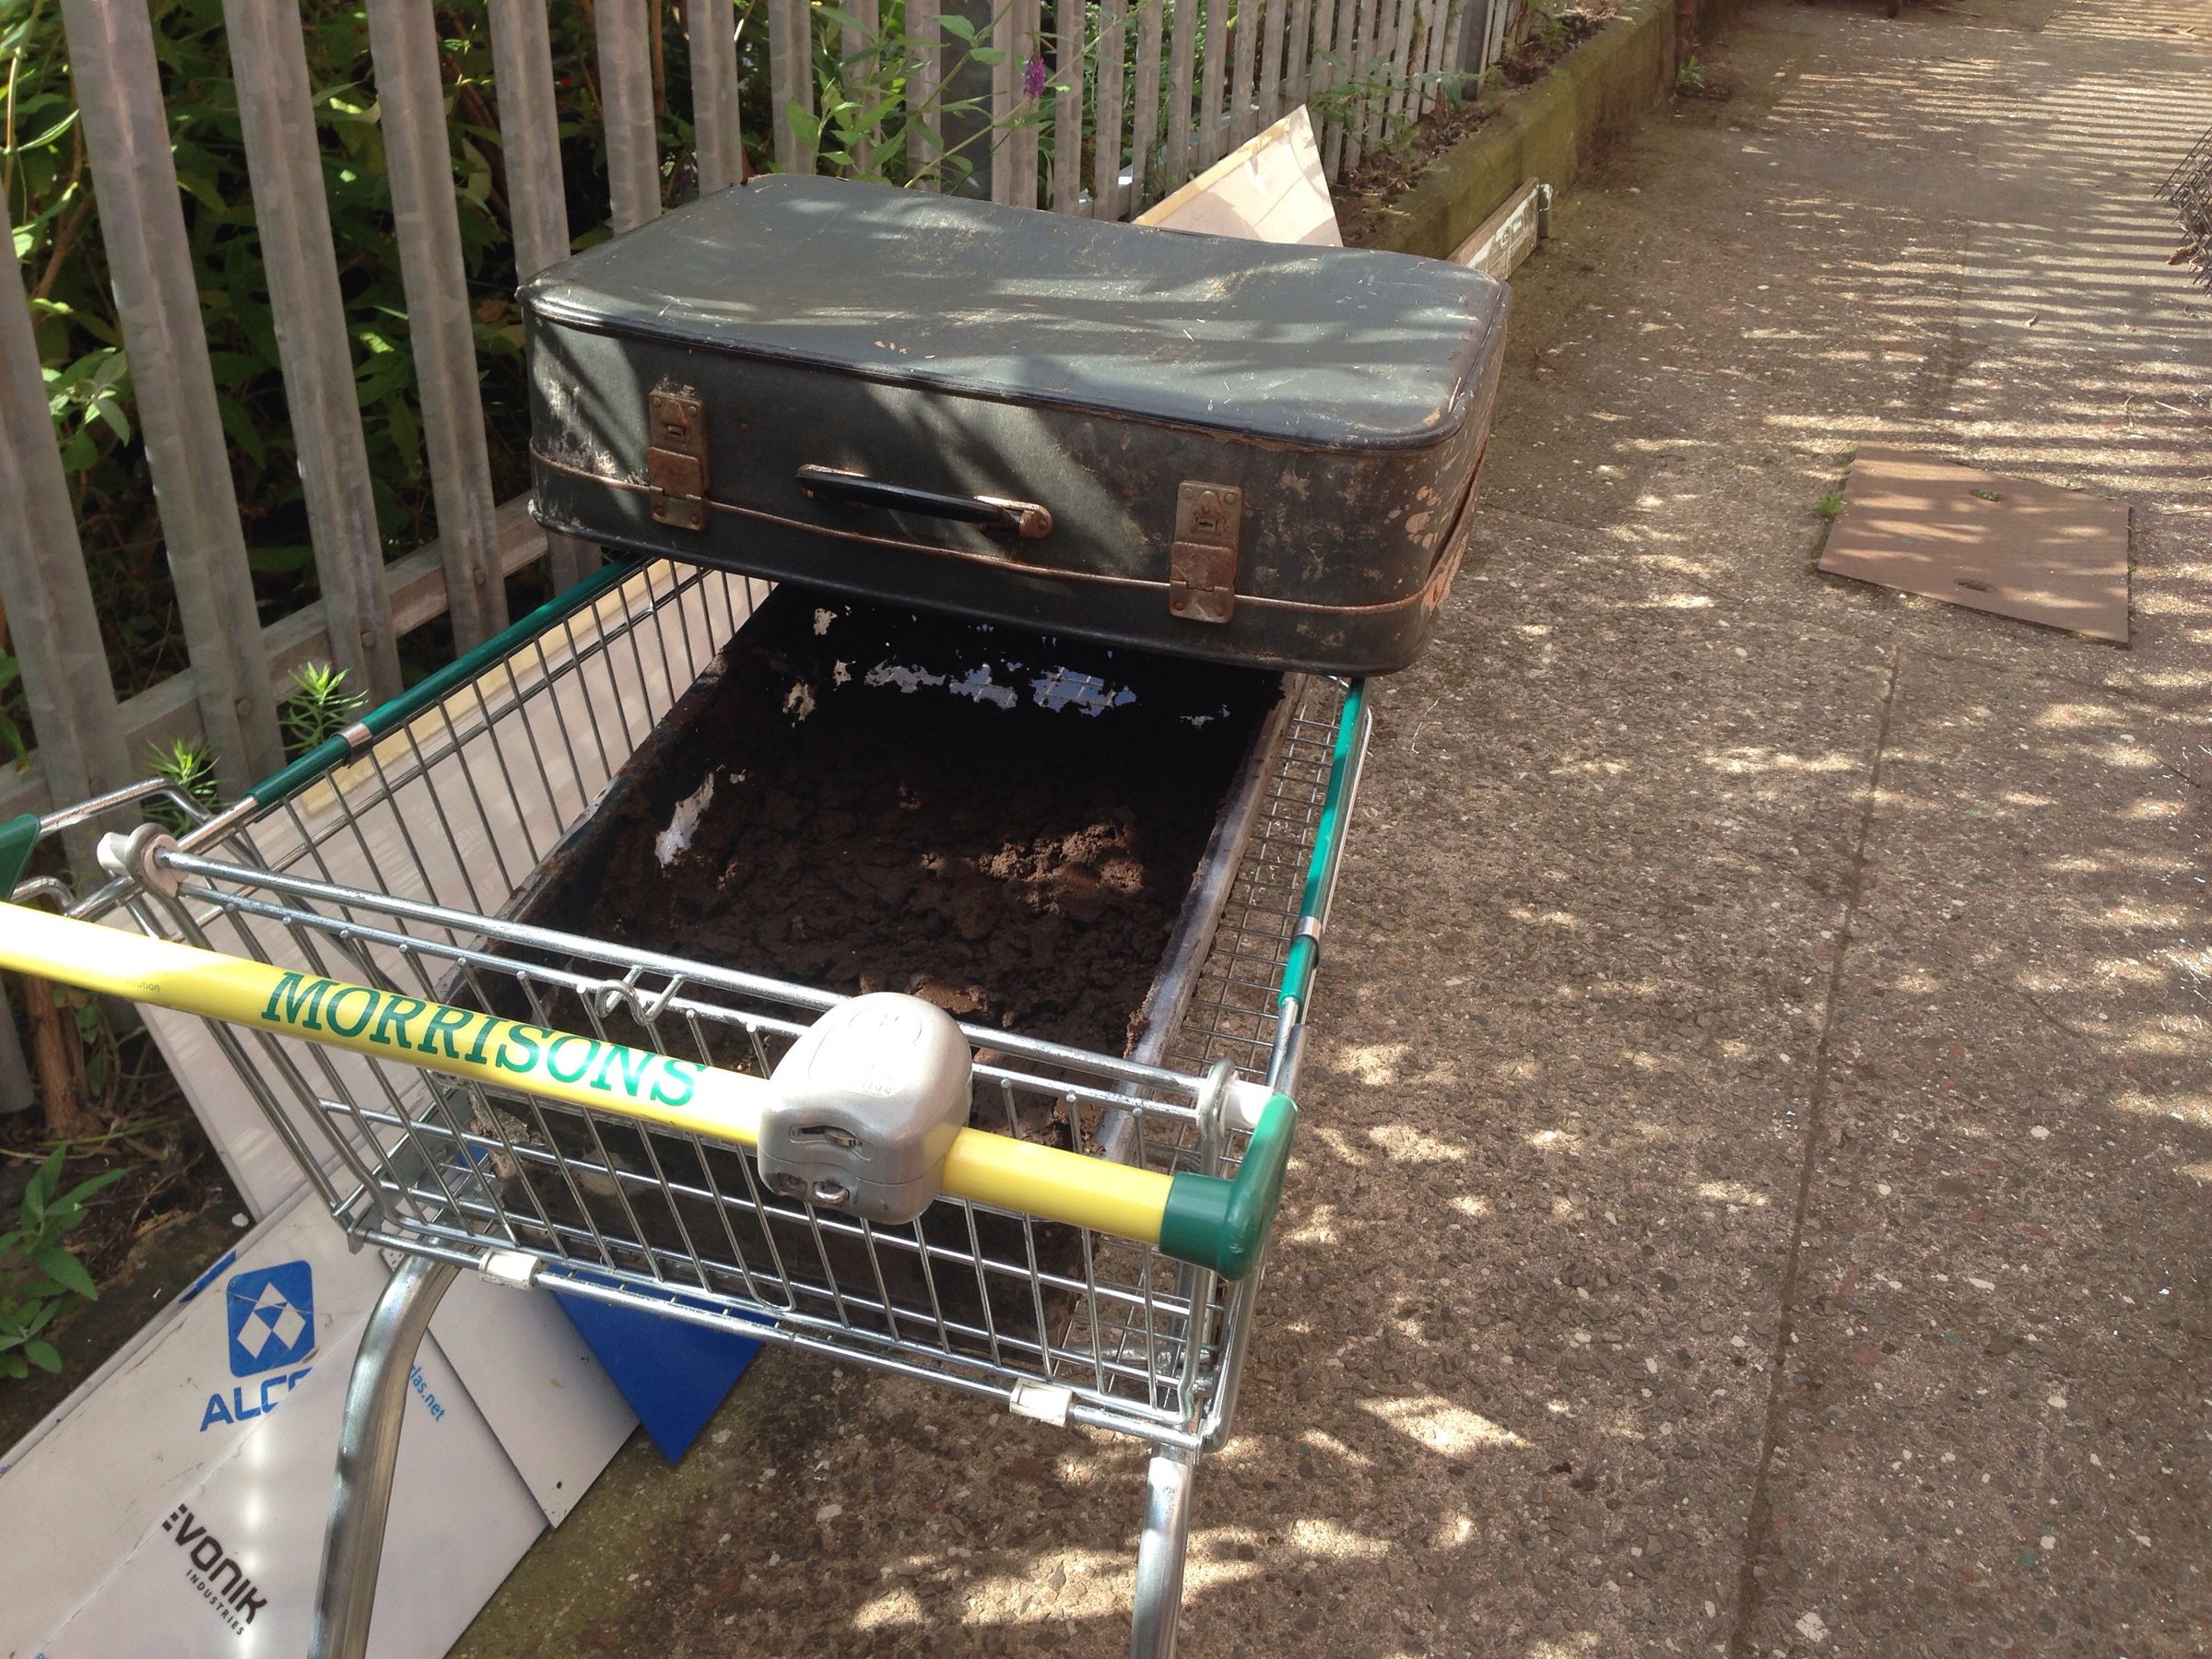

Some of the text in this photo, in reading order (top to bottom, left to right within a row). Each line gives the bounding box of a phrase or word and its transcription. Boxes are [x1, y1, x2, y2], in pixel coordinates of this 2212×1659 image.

[261, 971, 704, 1107] MORRISONS
[409, 1365, 445, 1422] las.net
[185, 1569, 245, 1636] INDUSTRIES
